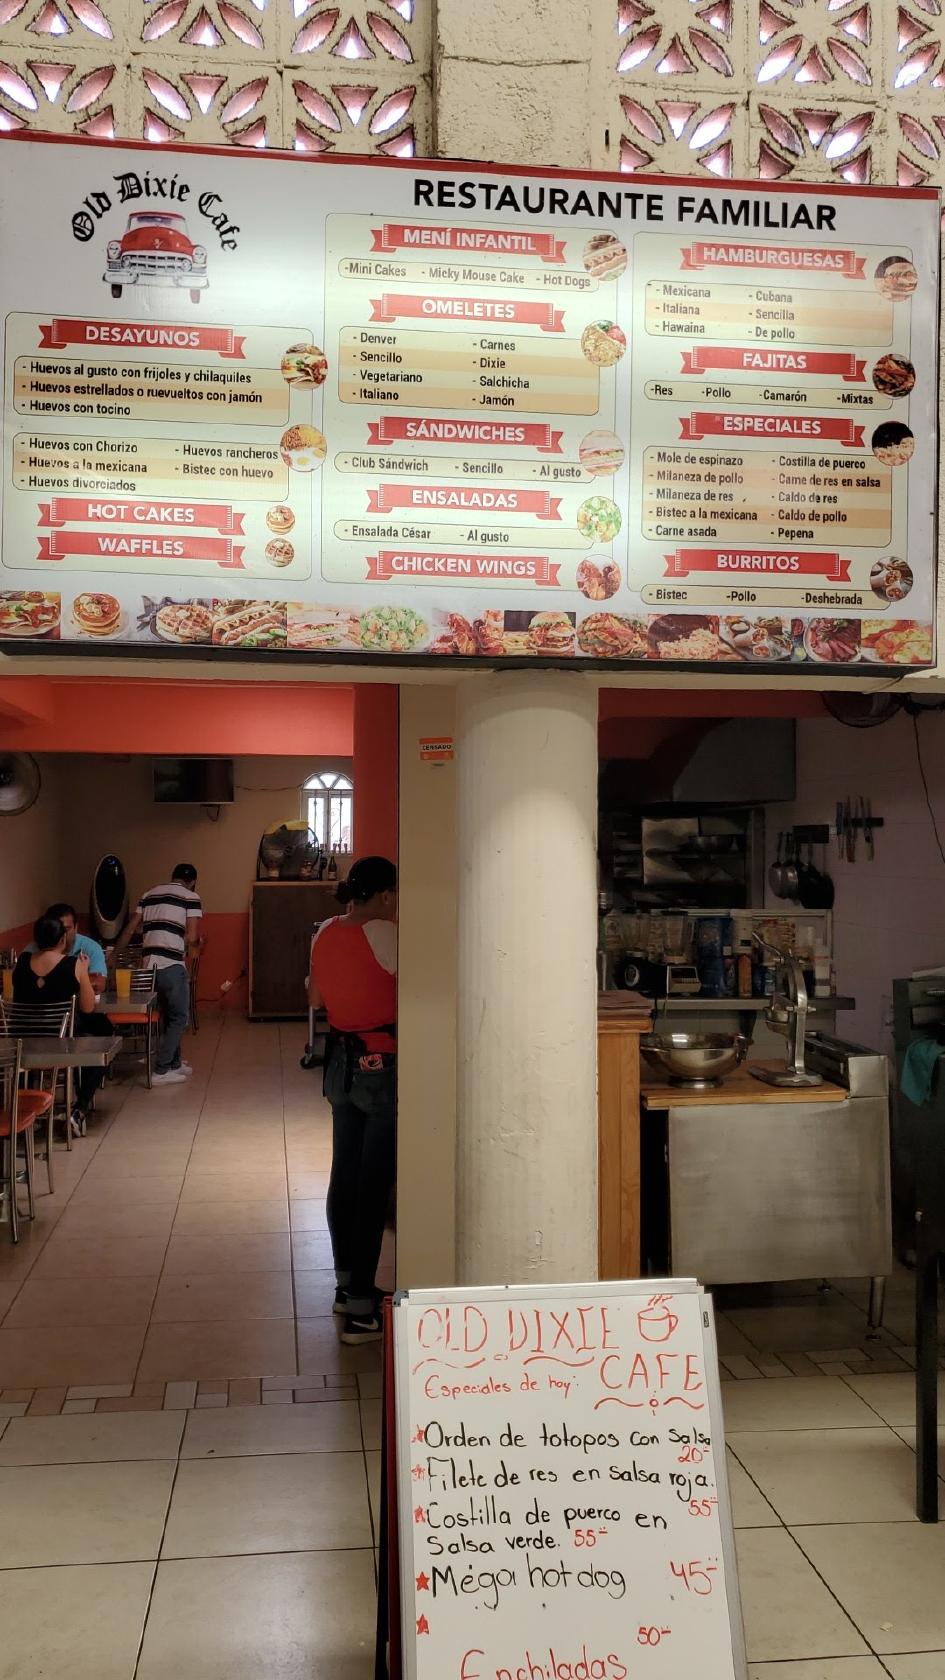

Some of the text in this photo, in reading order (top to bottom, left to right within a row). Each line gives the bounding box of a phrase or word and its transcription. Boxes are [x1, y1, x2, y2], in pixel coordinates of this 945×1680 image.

[415, 178, 836, 231] RESTAURANTE FAMILIAR
[71, 191, 112, 242] Old
[197, 192, 240, 251] Cafe
[456, 233, 536, 250] INFANTIL
[703, 247, 844, 267] HAMBURGUESAS
[374, 264, 406, 277] Cakes
[429, 268, 524, 283] Micky Mouse Cake
[543, 275, 590, 289] Hot Dogs
[662, 286, 711, 298] Mexicana
[755, 291, 792, 303] Cubana
[422, 299, 515, 318] OMELETES
[662, 303, 700, 316] Italiana
[755, 309, 794, 321] Sencilla
[662, 322, 705, 333] Hawaina
[755, 327, 795, 340] De pollo
[86, 326, 200, 346] DESAYUNOS
[360, 333, 397, 345] Denver
[480, 339, 516, 351] Carnes
[360, 351, 402, 363] Sencillo
[480, 358, 505, 369] Dixie
[743, 352, 807, 369] FAJITAS
[30, 362, 251, 385] Huevos al gusto con frijoles y chilaquiles
[360, 370, 422, 385] Vegetariano
[479, 376, 530, 389] Salchicha
[30, 382, 262, 404] Huevos estrellados o ruevueltos con jamón
[359, 388, 399, 401] Italiano
[479, 394, 515, 407] Jamón
[29, 401, 131, 416] Huevos con tocino
[406, 420, 525, 442] SÁNDWICHES
[723, 417, 821, 434] ESPECIALES
[29, 438, 138, 453] Huevos con Chorizo
[183, 445, 278, 460] Huevos rancheros
[29, 458, 147, 473] Huevos a la mexicana
[352, 457, 429, 471] Club Sándwich
[463, 462, 503, 474] Sencillo
[657, 453, 743, 468] Mole de espinazo
[779, 457, 866, 471] Costilla de puerco
[182, 464, 274, 478] Bistec con huevo
[539, 465, 581, 479] Al gusto
[657, 471, 744, 486] Milaneza de pollo
[28, 476, 136, 492] Huevos divorciados
[809, 475, 822, 486] de
[824, 477, 838, 487] res
[842, 478, 853, 487] en
[856, 476, 880, 488] salsa
[412, 489, 518, 508] ENSALADAS
[656, 489, 733, 501] Milaneza de res
[778, 493, 838, 504] Caldo de res
[87, 503, 194, 522] HOT CAKES
[656, 507, 757, 521] Bistec a la mexicana
[778, 510, 847, 523] Caldo de pollo
[352, 525, 431, 539] Ensalada César
[467, 530, 509, 543] Al gusto
[656, 525, 717, 537] Carne asada
[778, 528, 814, 540] Pepena
[98, 537, 184, 555] WAFFLES
[391, 556, 536, 576] CHICKEN WINGS
[717, 554, 800, 570] BURRITOS
[656, 589, 688, 600] Bistec
[507, 1306, 620, 1354] DIXIE
[600, 1353, 704, 1392] CAFE
[424, 1374, 512, 1400] Especiales
[520, 1372, 539, 1392] de
[424, 1421, 491, 1449] Orden
[500, 1423, 525, 1448] de
[540, 1422, 620, 1454] totopos
[426, 1457, 488, 1492] Filete
[495, 1462, 521, 1487] de
[530, 1468, 558, 1483] res
[573, 1466, 600, 1483] en
[426, 1495, 668, 1530] Costilla de puerco en
